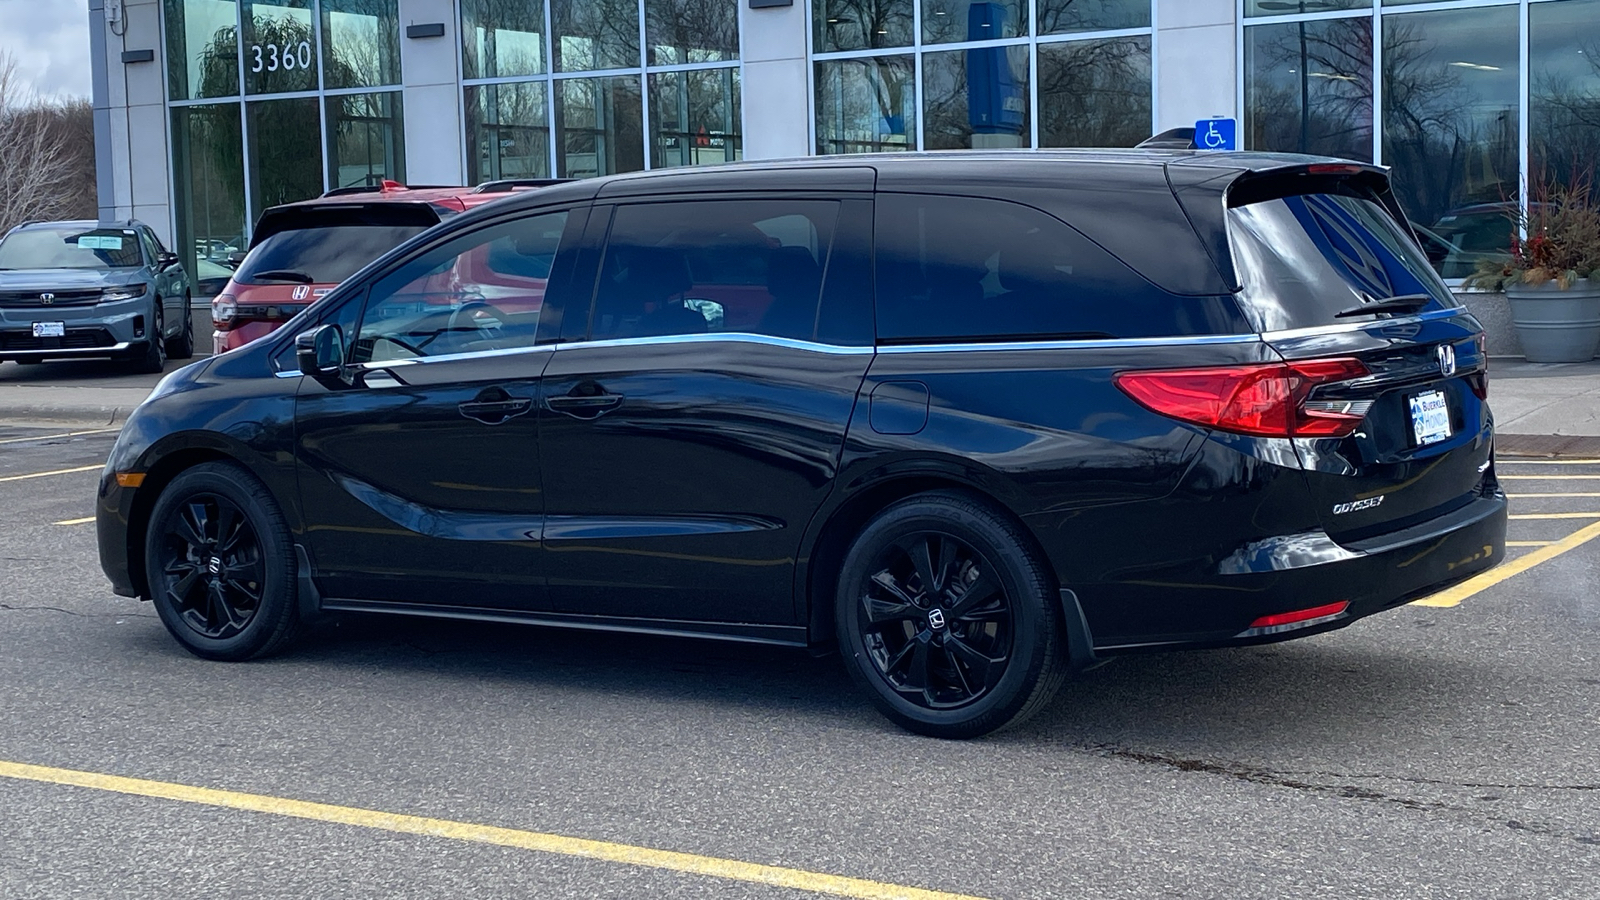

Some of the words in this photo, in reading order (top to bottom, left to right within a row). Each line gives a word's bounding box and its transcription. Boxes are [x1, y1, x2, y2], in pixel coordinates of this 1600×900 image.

[252, 41, 311, 73] 3360
[1424, 412, 1448, 429] HONDA
[1333, 495, 1384, 514] ODYSSEY
